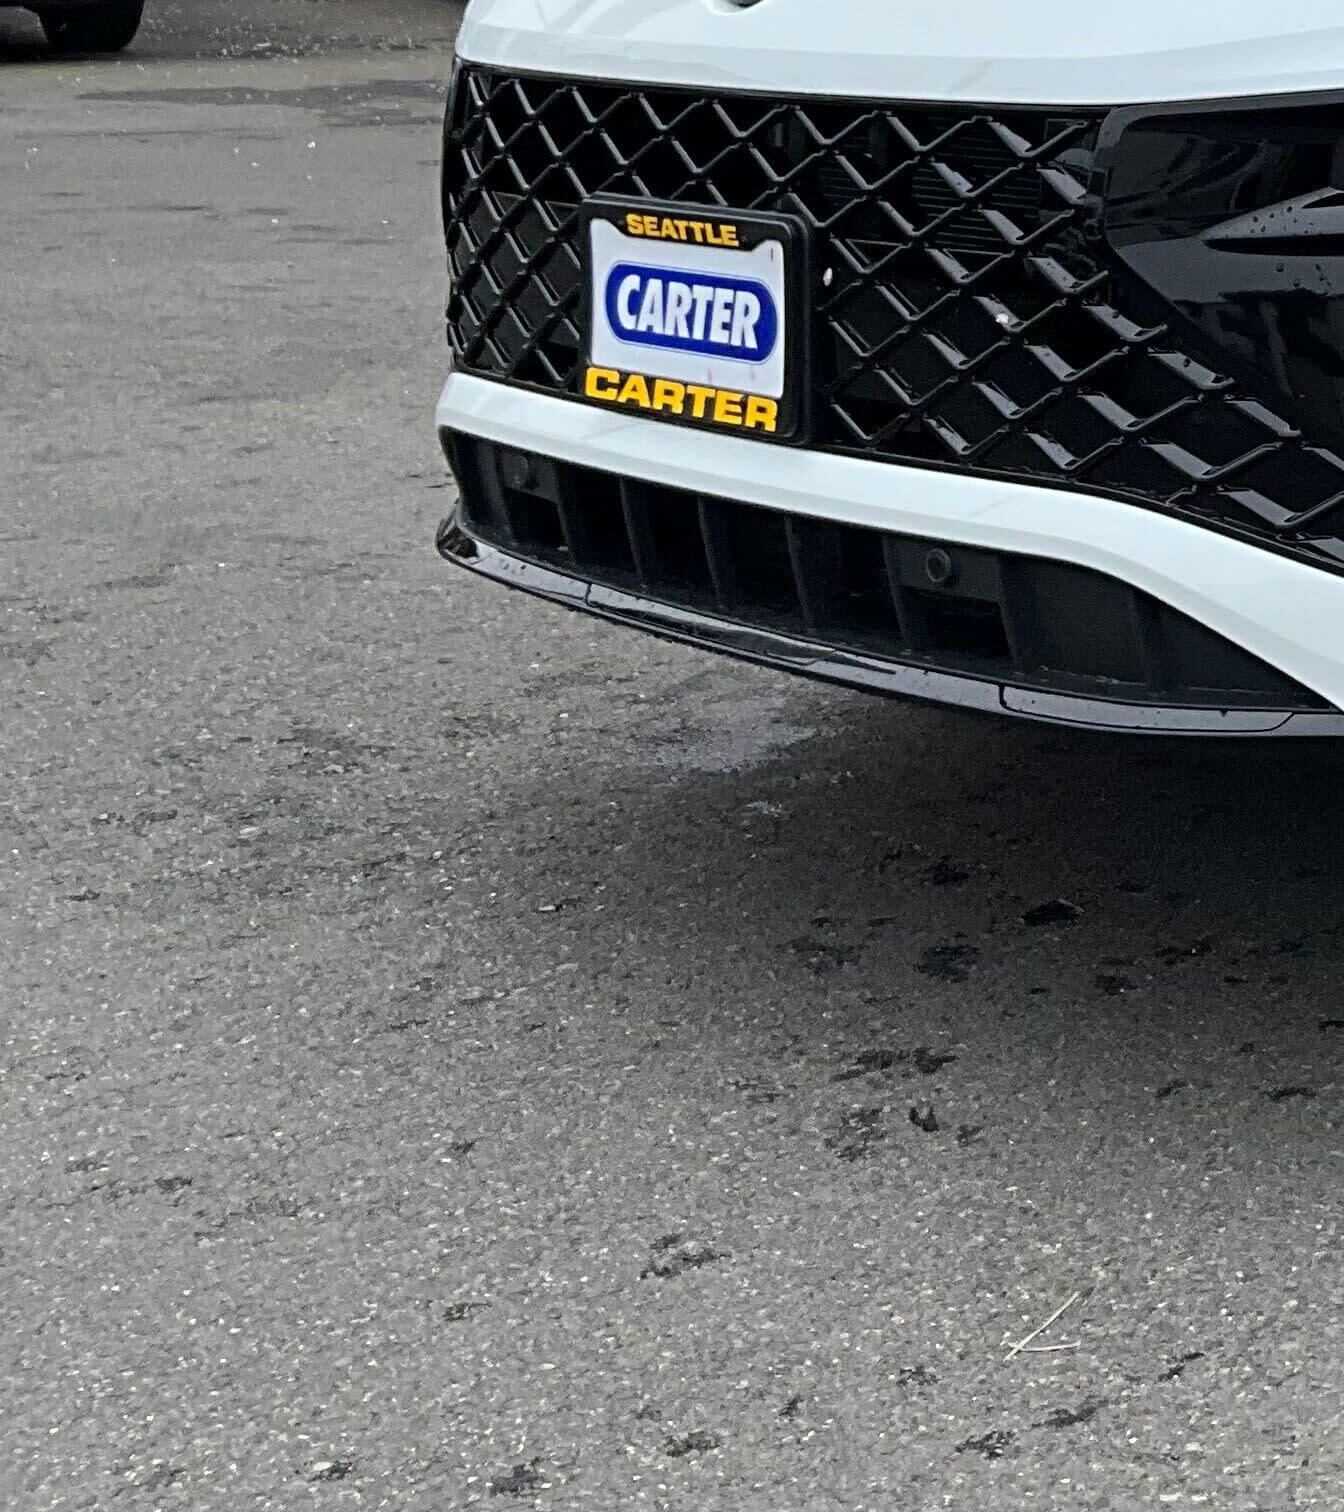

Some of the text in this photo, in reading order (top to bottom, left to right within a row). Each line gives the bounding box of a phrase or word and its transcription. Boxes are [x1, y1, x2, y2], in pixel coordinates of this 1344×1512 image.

[625, 213, 739, 247] SEATTLE
[616, 274, 761, 349] CARTER
[585, 366, 778, 432] CARTER
